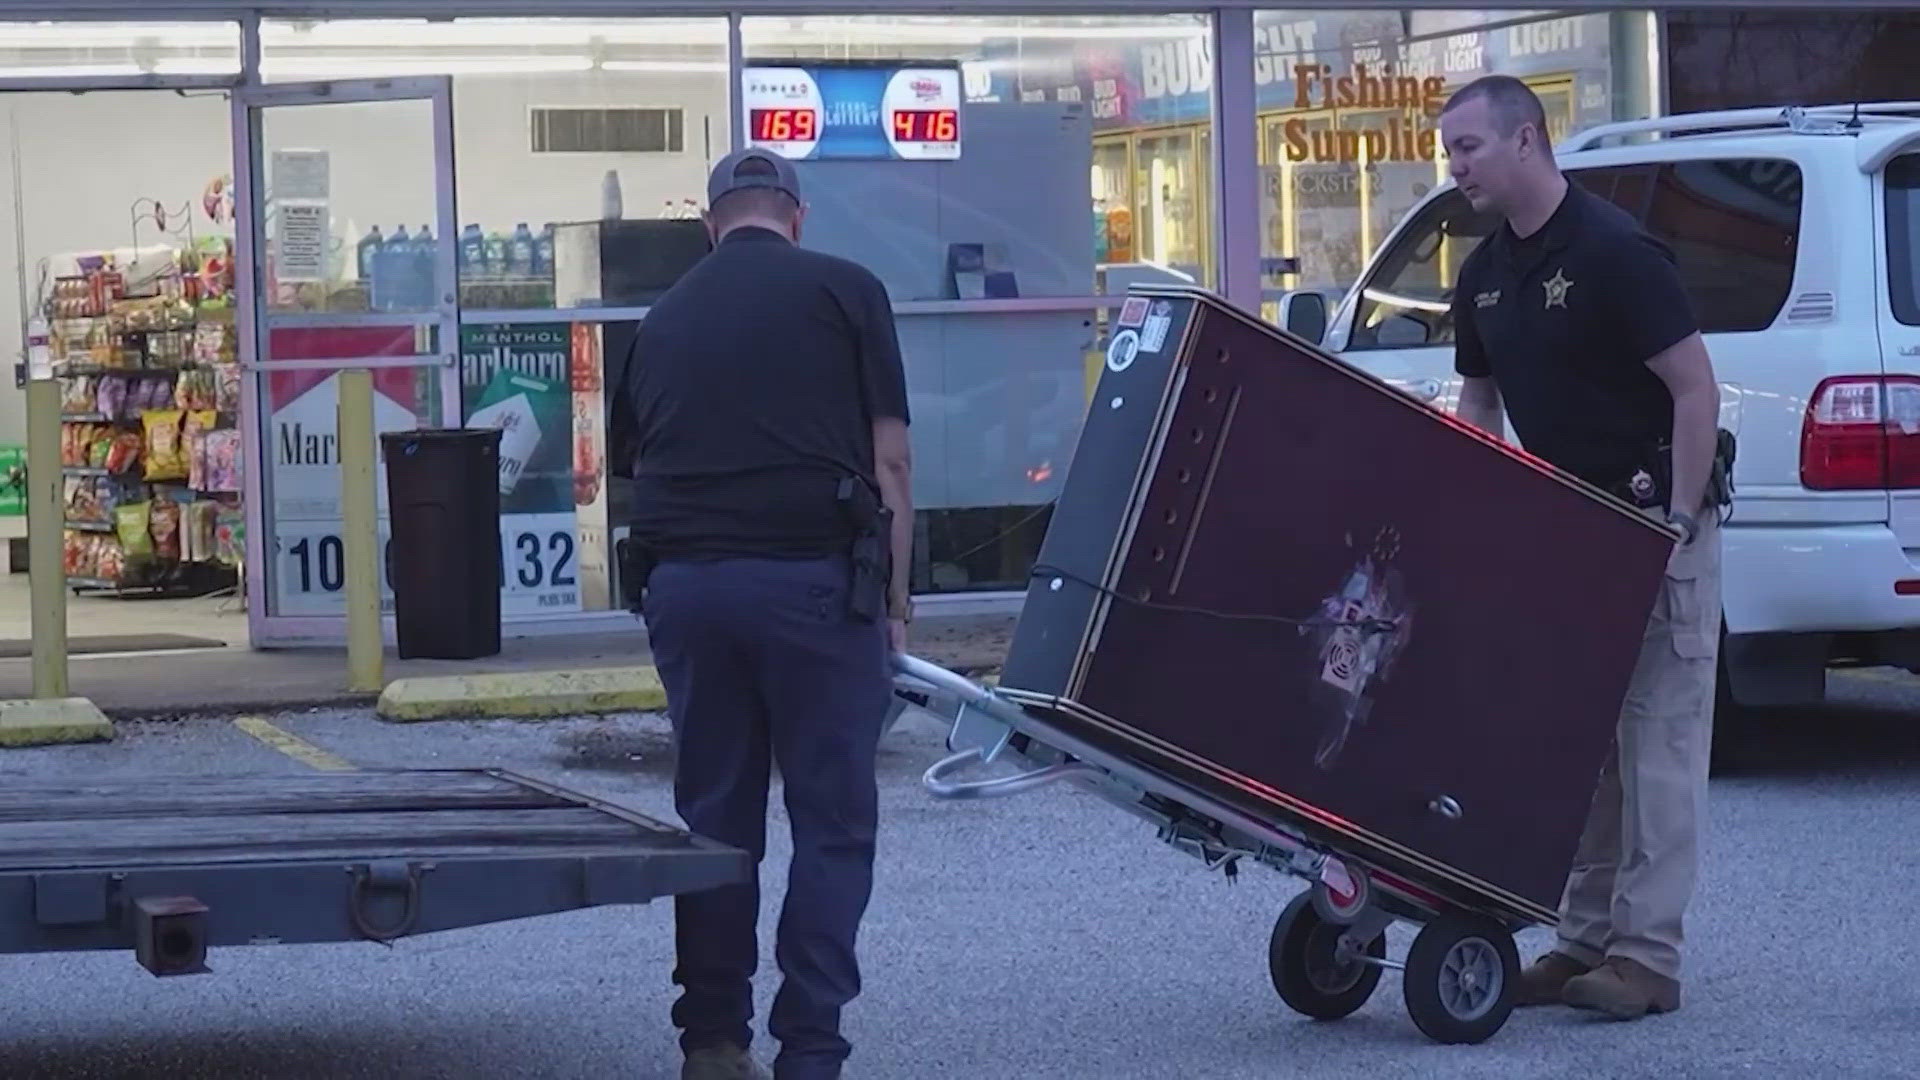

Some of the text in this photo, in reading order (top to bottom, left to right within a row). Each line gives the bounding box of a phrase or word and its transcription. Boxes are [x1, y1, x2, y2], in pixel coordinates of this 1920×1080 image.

[1141, 20, 1317, 98] BUD GHT
[1294, 63, 1446, 117] Fishing
[762, 110, 814, 139] 169
[896, 112, 955, 140] 416
[1285, 118, 1450, 171] Supplie
[472, 331, 563, 343] MENTHOL
[463, 347, 566, 386] arlboro
[280, 404, 341, 465] Marl
